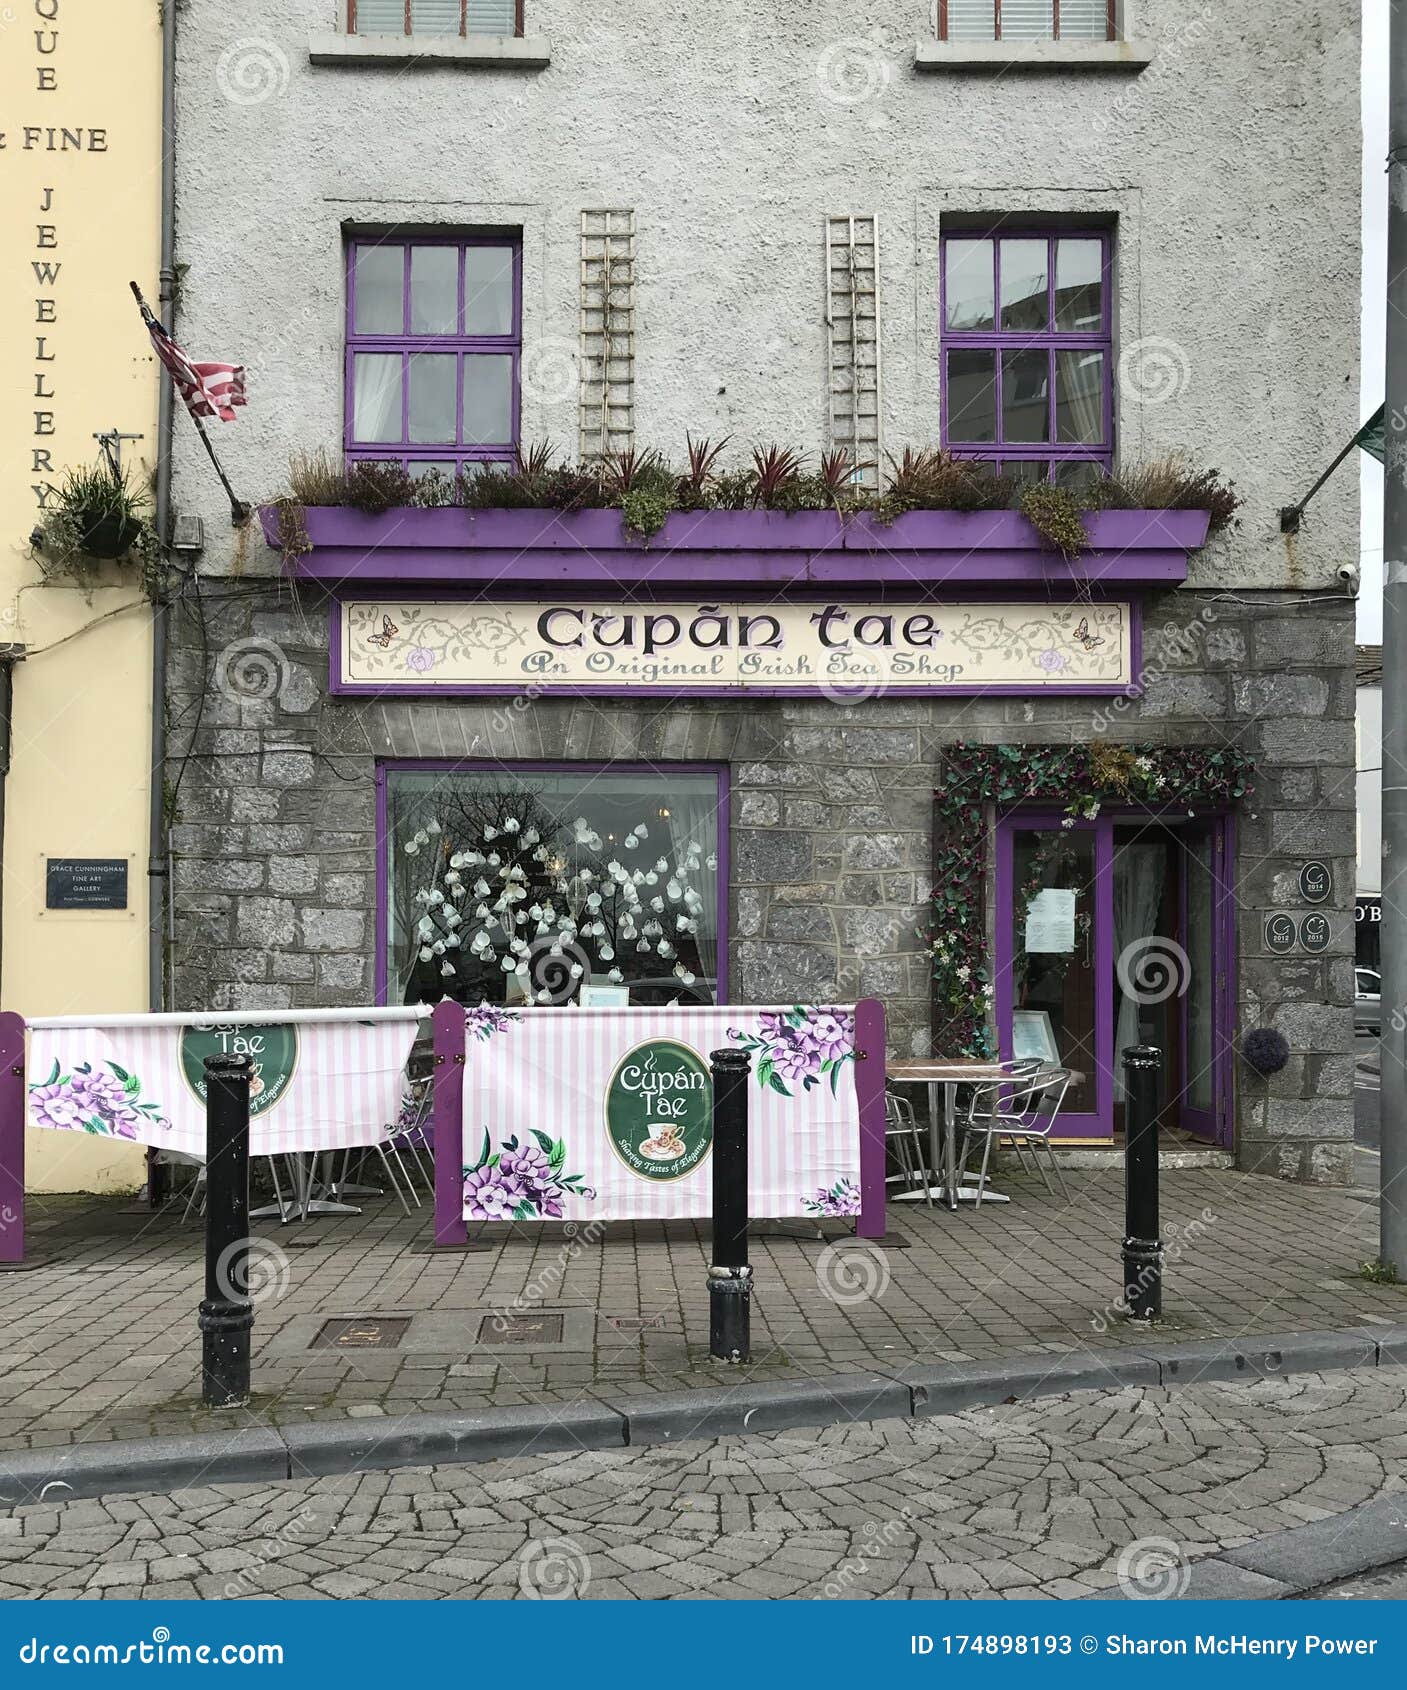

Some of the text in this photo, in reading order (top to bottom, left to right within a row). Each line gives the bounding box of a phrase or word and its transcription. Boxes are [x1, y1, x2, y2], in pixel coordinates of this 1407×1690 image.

[23, 127, 108, 152] FINE
[31, 188, 62, 510] JEWELLERY
[810, 604, 945, 650] tae
[520, 649, 964, 682] An Original Irish Tea Shop
[215, 1030, 266, 1057] Tae
[620, 1065, 706, 1096] Cupán
[640, 1090, 688, 1118] Tae
[618, 1137, 707, 1176] Sharing Tastes of Elegance
